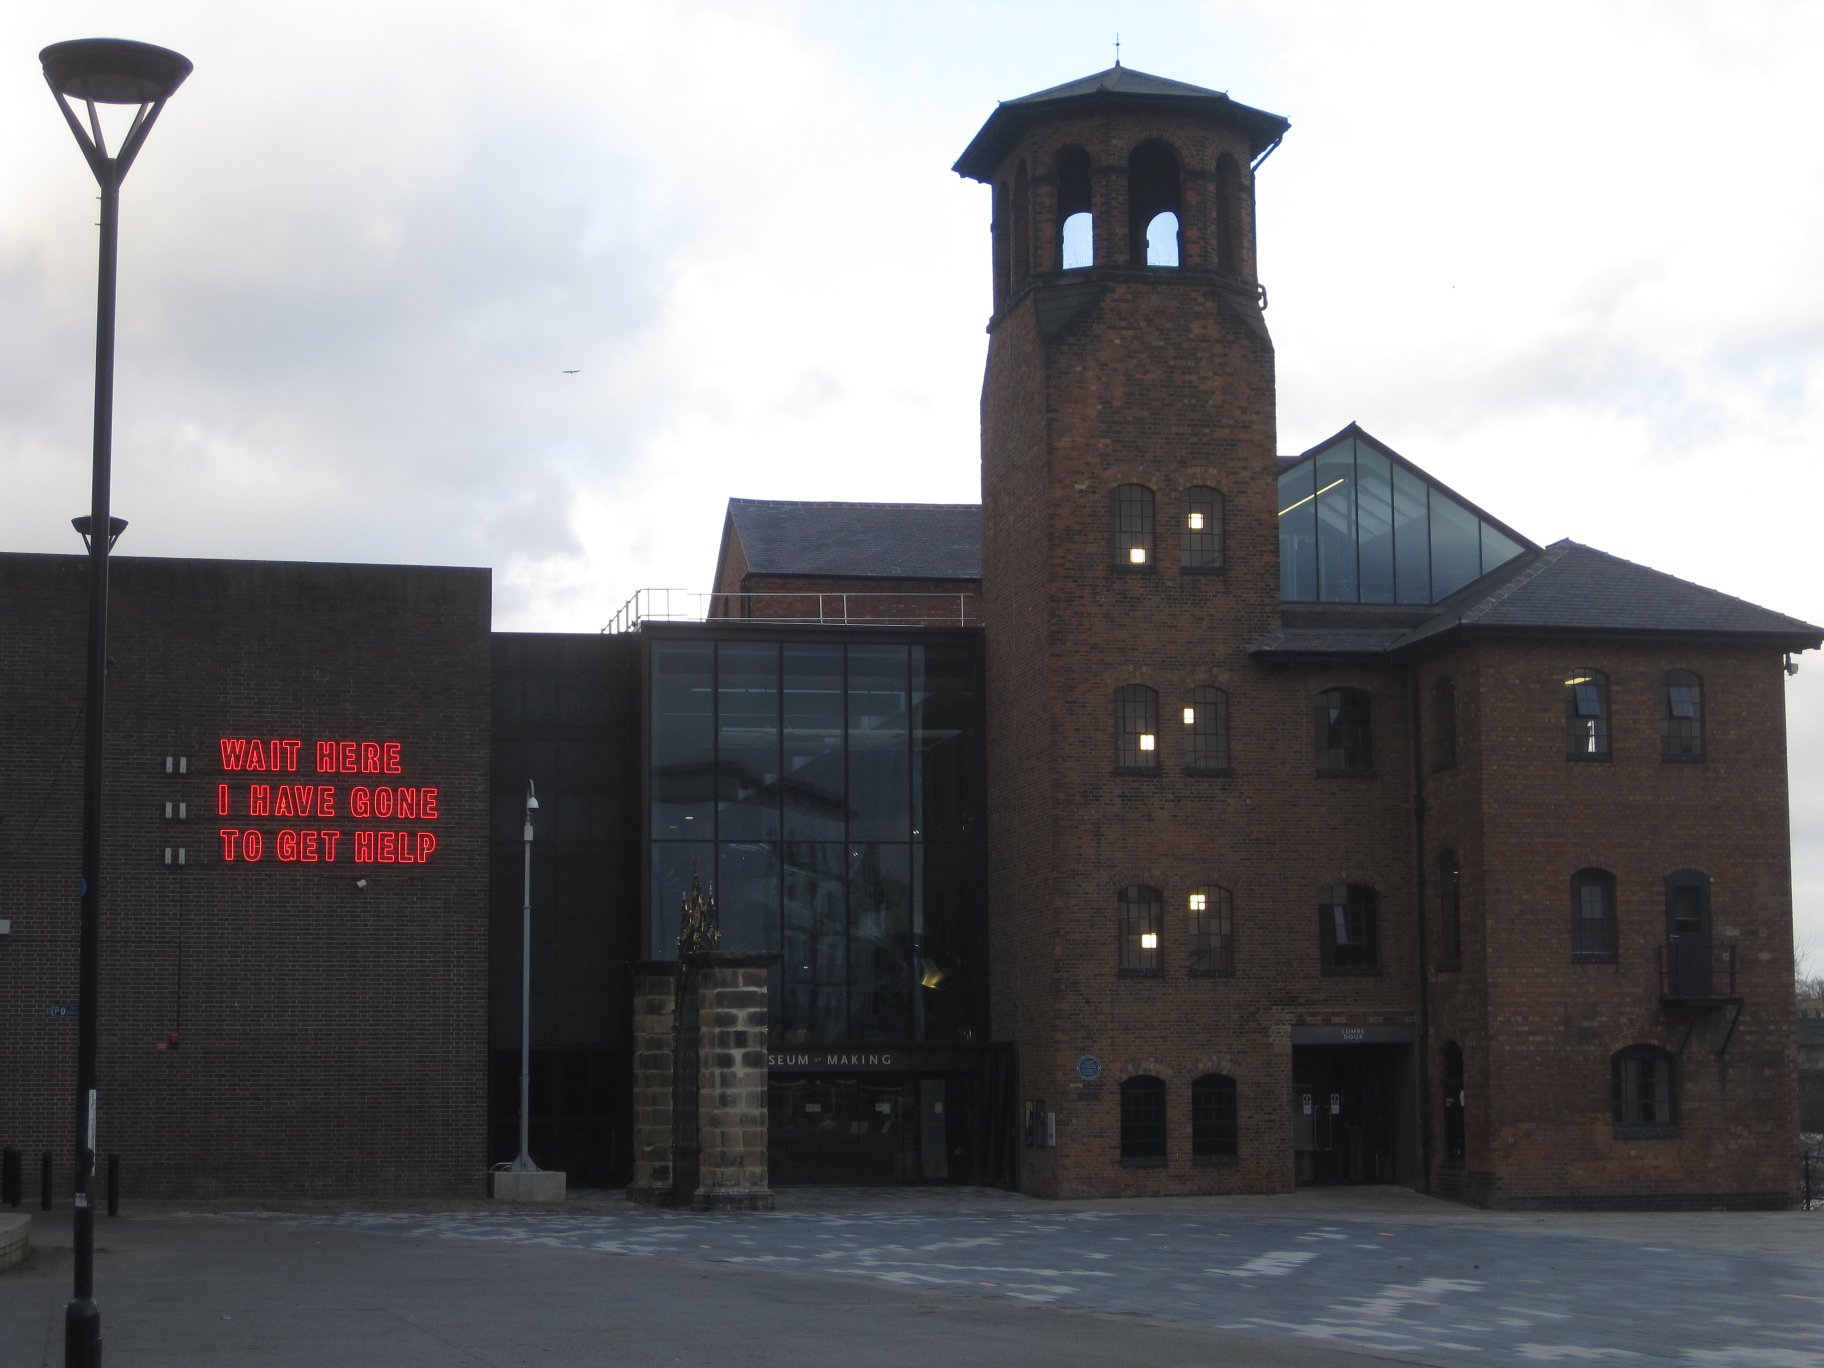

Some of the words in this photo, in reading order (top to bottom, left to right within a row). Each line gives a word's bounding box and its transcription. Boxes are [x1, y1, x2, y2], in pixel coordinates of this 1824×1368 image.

[220, 739, 301, 770] WAIT
[316, 741, 402, 774] HERE
[218, 784, 228, 815] I
[250, 784, 335, 817] HAVE
[350, 786, 438, 819] GONE
[220, 829, 262, 861] TO
[277, 829, 340, 862] GET
[355, 831, 436, 863] HELP
[768, 1054, 809, 1065] SEUM
[827, 1054, 891, 1065] MAKING
